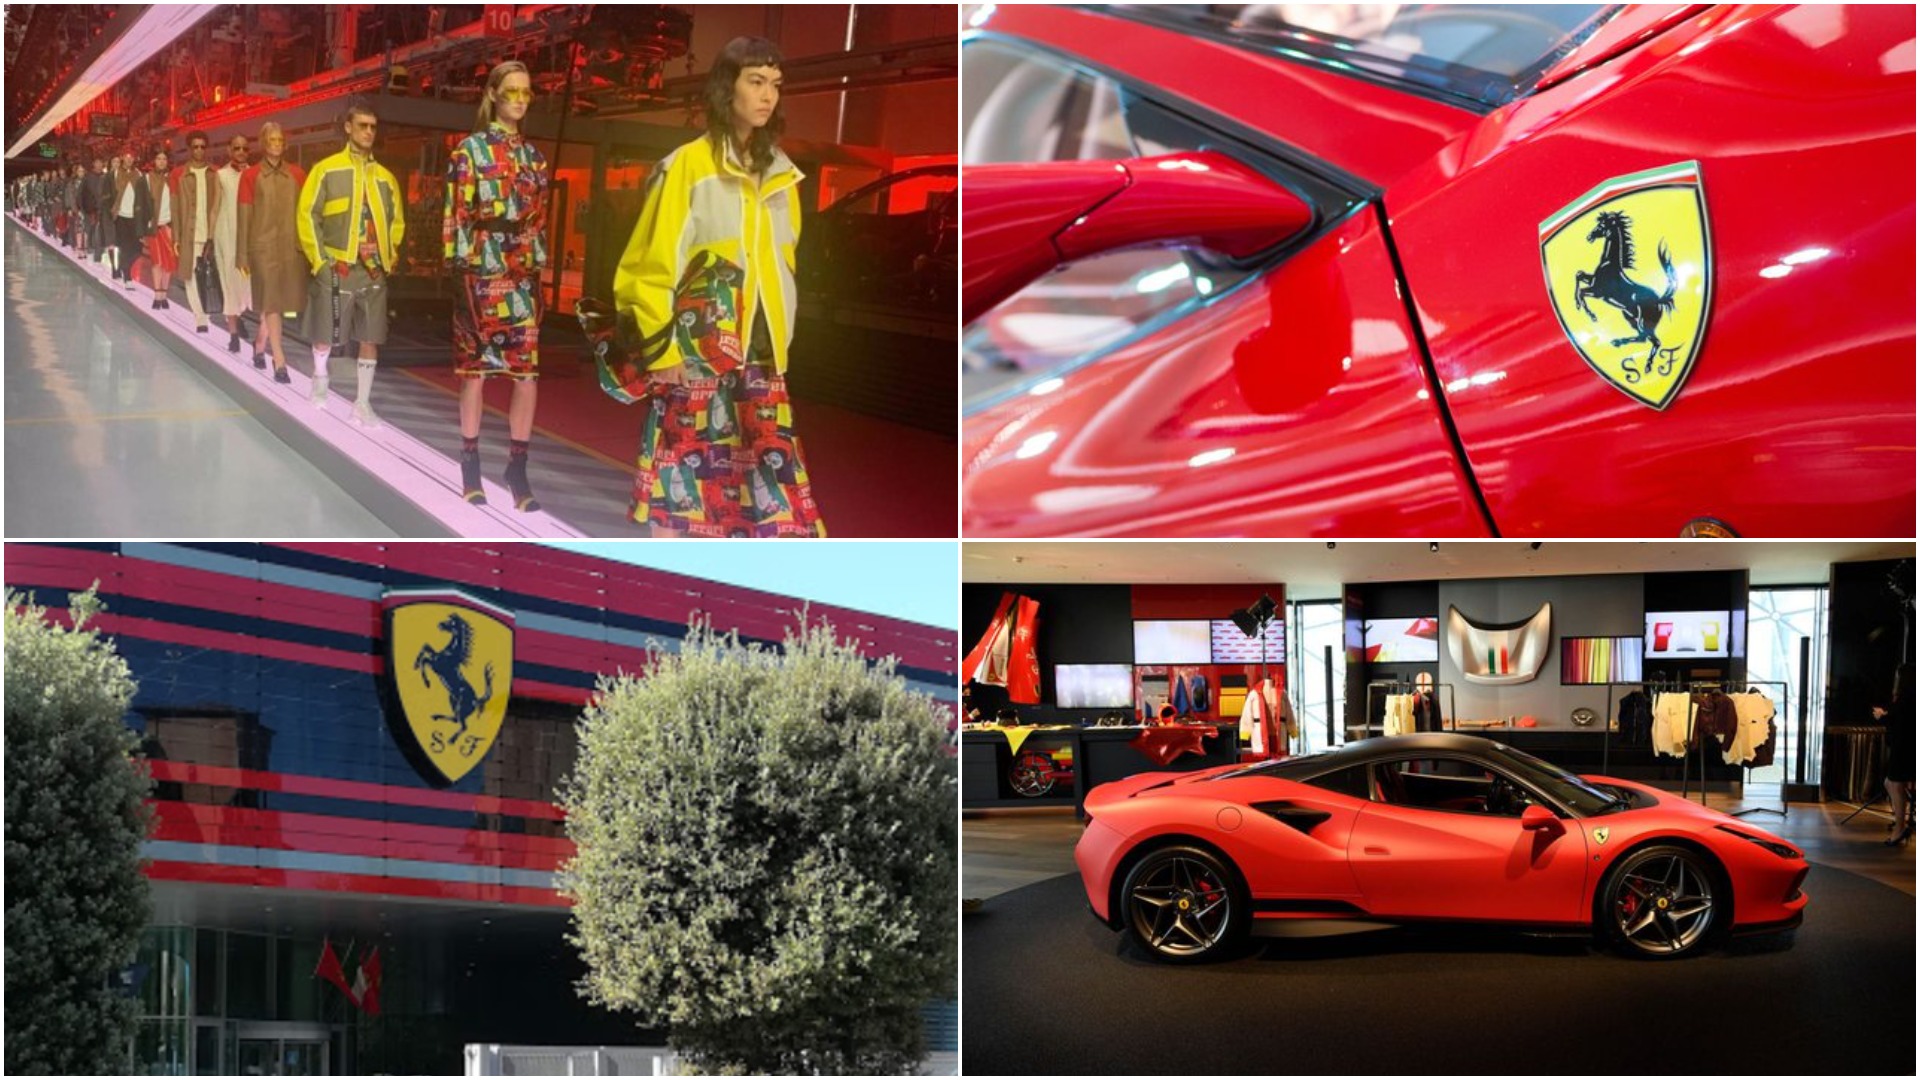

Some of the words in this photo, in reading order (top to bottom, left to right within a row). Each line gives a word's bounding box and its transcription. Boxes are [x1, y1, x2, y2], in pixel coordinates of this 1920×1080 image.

[489, 10, 511, 31] 10
[1621, 356, 1641, 384] S
[1657, 343, 1685, 376] F
[430, 730, 446, 754] S
[460, 735, 486, 758] F
